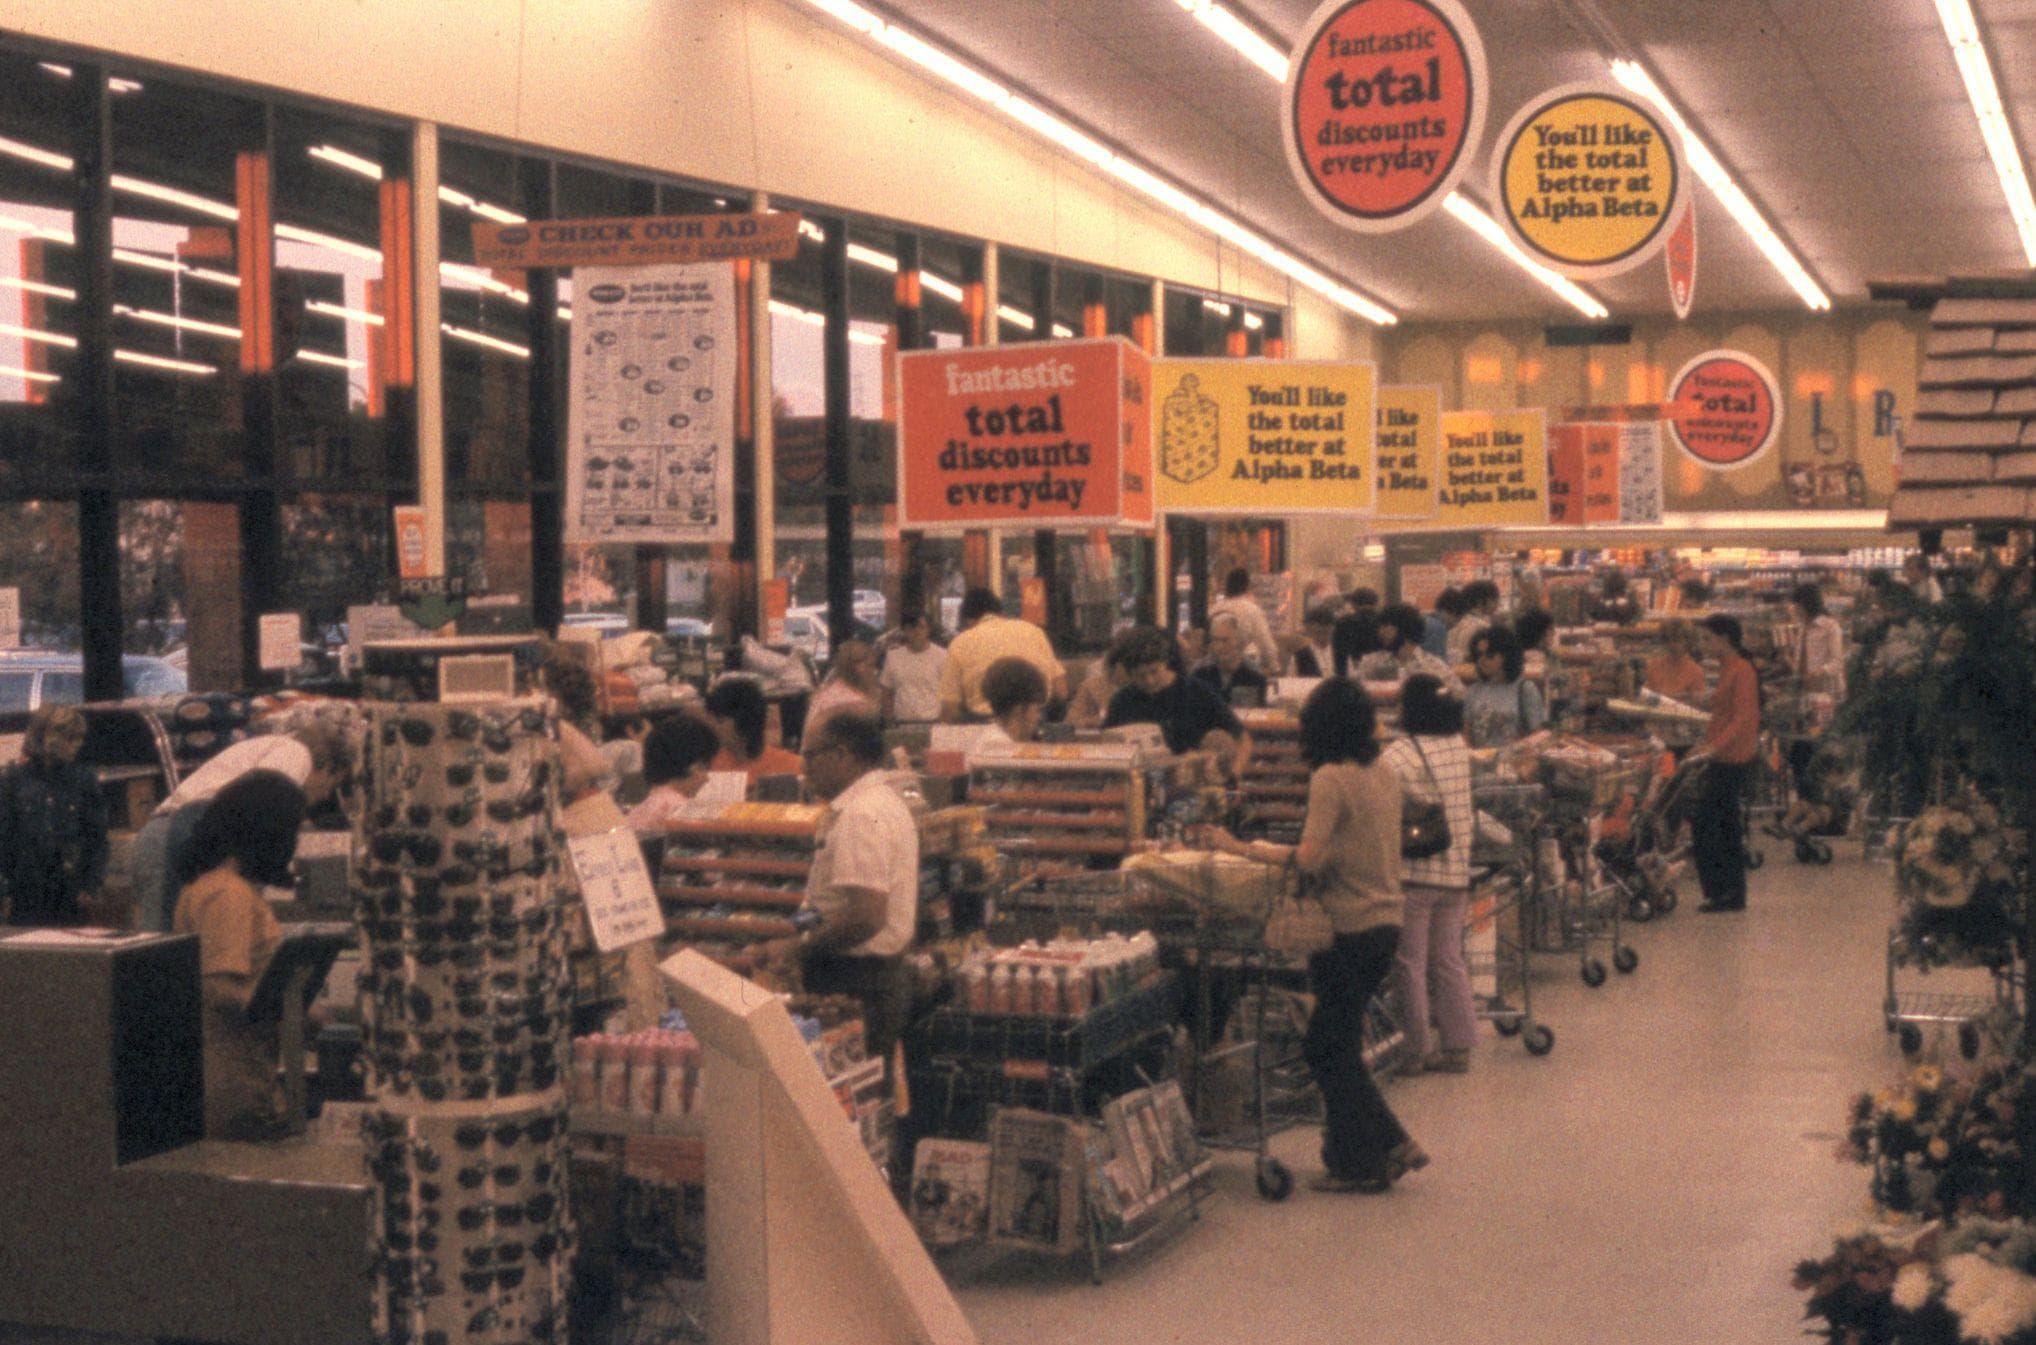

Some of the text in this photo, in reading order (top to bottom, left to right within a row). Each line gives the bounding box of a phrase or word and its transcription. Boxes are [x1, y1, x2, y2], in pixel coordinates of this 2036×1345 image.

[1329, 27, 1435, 58] fantastic
[1324, 57, 1441, 110] total
[1318, 117, 1445, 145] discounts
[1603, 123, 1652, 145] like
[1322, 145, 1439, 176] everyday
[1535, 147, 1649, 169] the total
[1537, 171, 1653, 194] better at
[1520, 195, 1659, 223] Alpha Beta
[539, 225, 633, 242] CHECK
[714, 218, 758, 239] AD
[946, 358, 1077, 396] fantastic
[1307, 386, 1348, 406] like
[964, 393, 1064, 436] total
[1248, 411, 1344, 431] the total
[1387, 408, 1419, 427] like
[1248, 434, 1346, 456] better at
[1493, 430, 1524, 446] like
[938, 439, 1092, 471] discounts
[1447, 448, 1523, 467] the total
[1232, 458, 1303, 484] Alpha
[1309, 459, 1361, 480] Beta
[1390, 472, 1428, 490] Beta
[1448, 468, 1524, 486] better at
[946, 470, 1087, 511] everyday
[1438, 488, 1494, 508] Alpha
[1497, 485, 1537, 502] Beta
